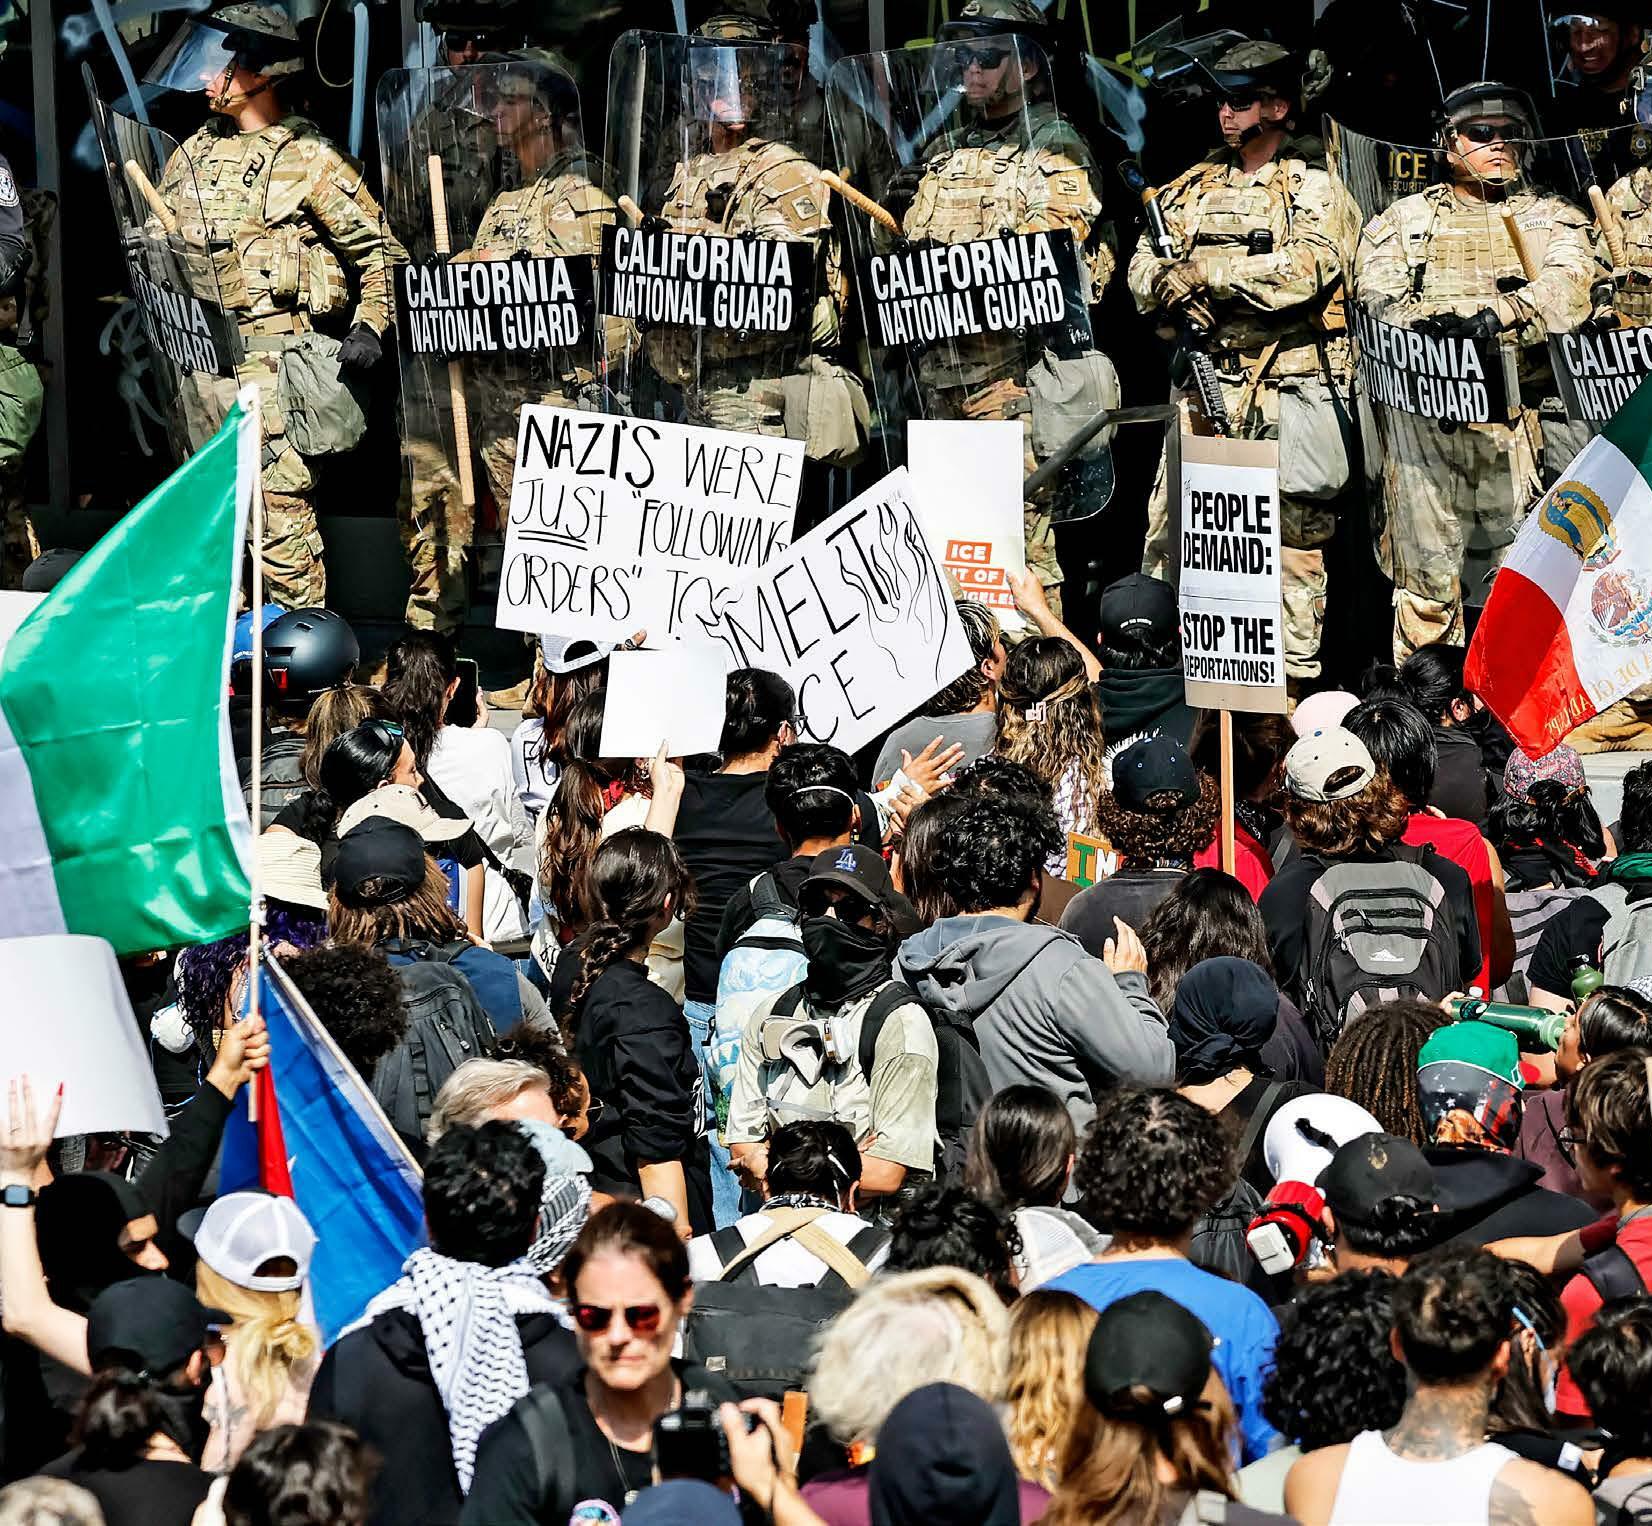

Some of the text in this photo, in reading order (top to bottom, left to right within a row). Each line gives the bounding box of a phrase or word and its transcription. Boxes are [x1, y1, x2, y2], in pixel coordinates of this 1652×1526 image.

[1388, 150, 1427, 179] ICE
[1523, 219, 1548, 230] ARMY
[614, 228, 793, 286] CALIFORNIA
[871, 233, 1059, 300] CALIFORNIA
[405, 257, 575, 309] CALIFORNIA
[612, 272, 792, 331] NATIONAL GUARD
[409, 302, 579, 353] NATIONAL GUARD
[878, 277, 1065, 347] NATIONAL GUARD
[161, 322, 219, 374] GUARD
[1416, 375, 1489, 423] GUARD
[522, 414, 792, 508] NAZI'S WERE
[1191, 490, 1272, 535] PEOPLE
[950, 544, 987, 561] ICE
[974, 569, 999, 583] OF
[1184, 531, 1273, 575] DEMAND:
[506, 552, 643, 621] ORDERS"
[1183, 611, 1275, 656] STOP THE
[1184, 654, 1275, 684] DEPORTATIONS!
[798, 649, 876, 743] CE
[834, 848, 857, 872] LA
